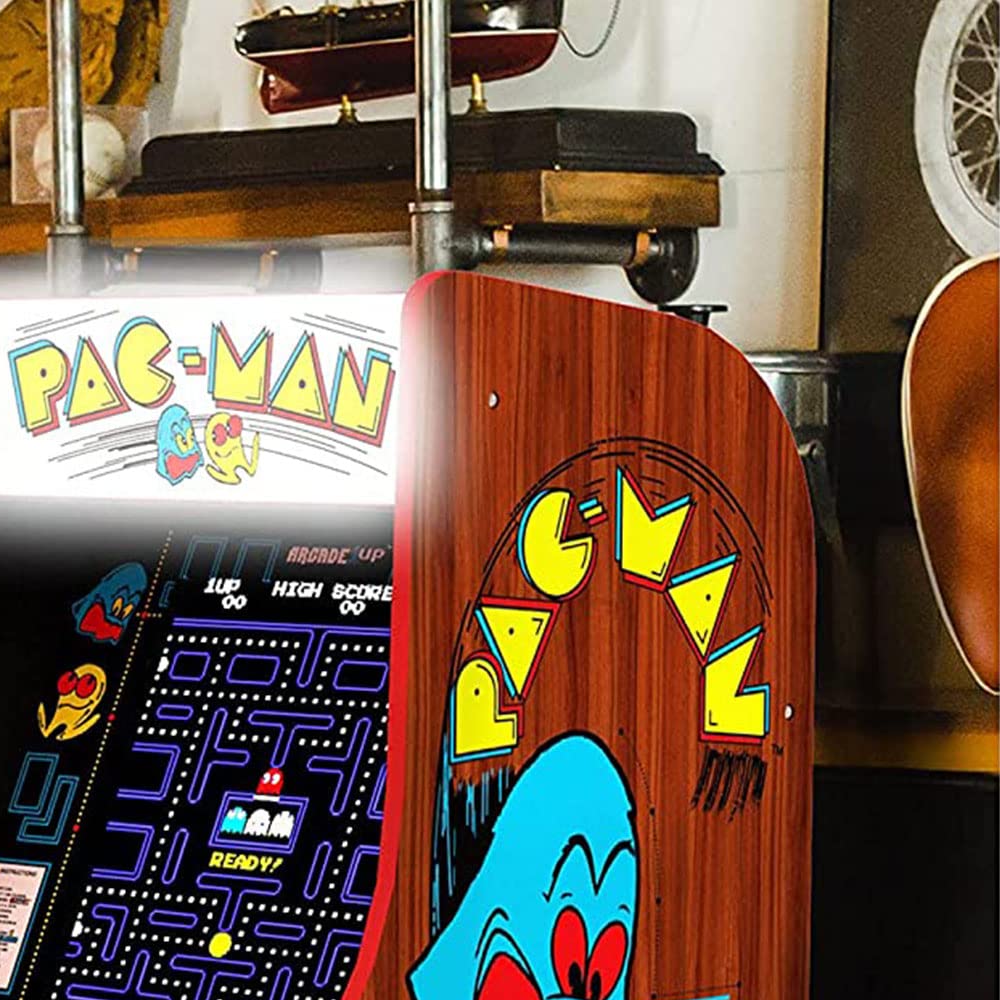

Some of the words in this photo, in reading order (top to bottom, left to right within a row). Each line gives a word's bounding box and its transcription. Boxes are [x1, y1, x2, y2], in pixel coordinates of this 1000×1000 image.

[8, 316, 395, 447] PAC-MAN
[204, 577, 241, 594] 1UP
[271, 581, 324, 598] HIGH
[331, 583, 393, 601] SCORE
[450, 465, 770, 764] PAC-MAN
[208, 851, 283, 873] READY!
